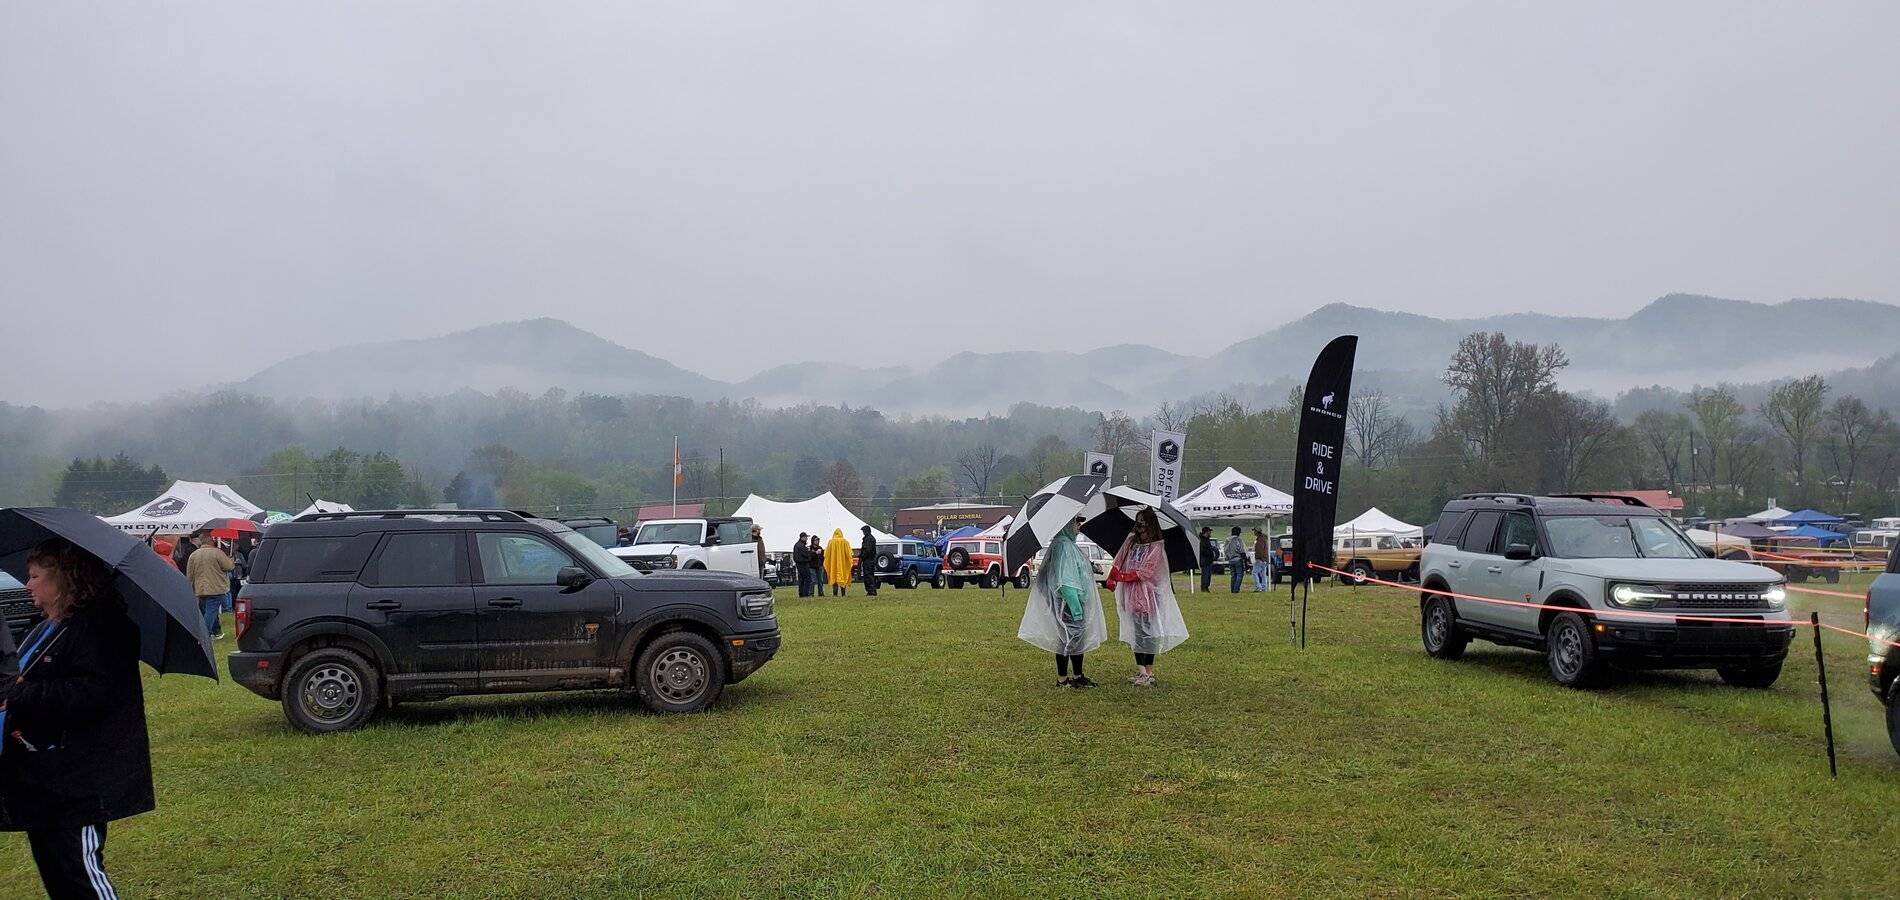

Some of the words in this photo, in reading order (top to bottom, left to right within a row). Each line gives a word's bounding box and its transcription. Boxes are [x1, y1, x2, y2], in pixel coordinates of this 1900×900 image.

[1310, 406, 1342, 419] BRONCO
[1312, 441, 1333, 459] RIDE
[1316, 461, 1324, 474] &
[1158, 467, 1166, 487] FOR
[1166, 469, 1174, 482] BY
[1304, 476, 1333, 495] DRIVE
